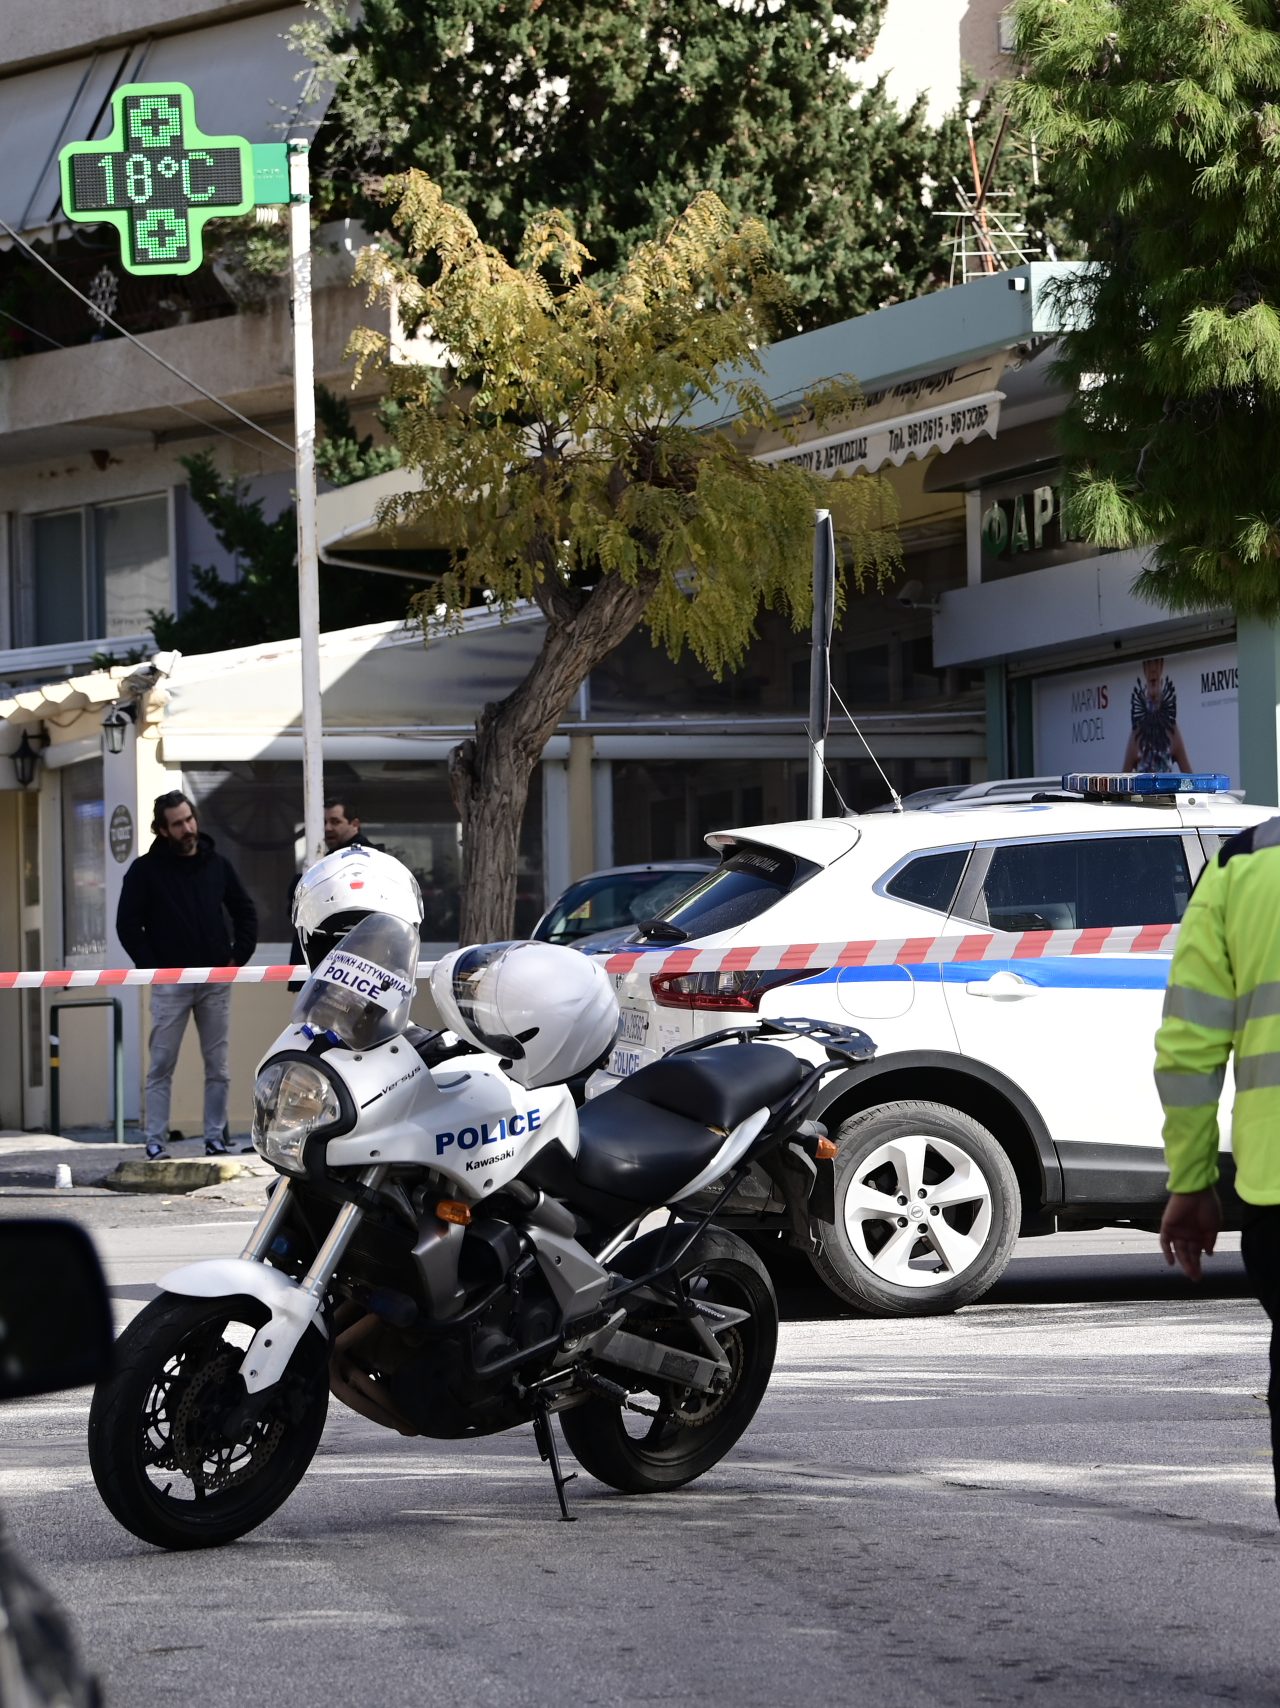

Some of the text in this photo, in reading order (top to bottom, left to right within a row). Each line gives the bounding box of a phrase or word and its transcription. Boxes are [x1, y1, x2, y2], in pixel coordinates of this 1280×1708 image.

[98, 152, 215, 204] 18°C
[907, 417, 943, 447] 9612615
[1071, 685, 1109, 713] MARVIS
[1072, 717, 1105, 744] MODEL
[323, 966, 382, 1000] POLICE
[435, 1108, 541, 1155] POLICE
[465, 1147, 515, 1171] Kawasaki
